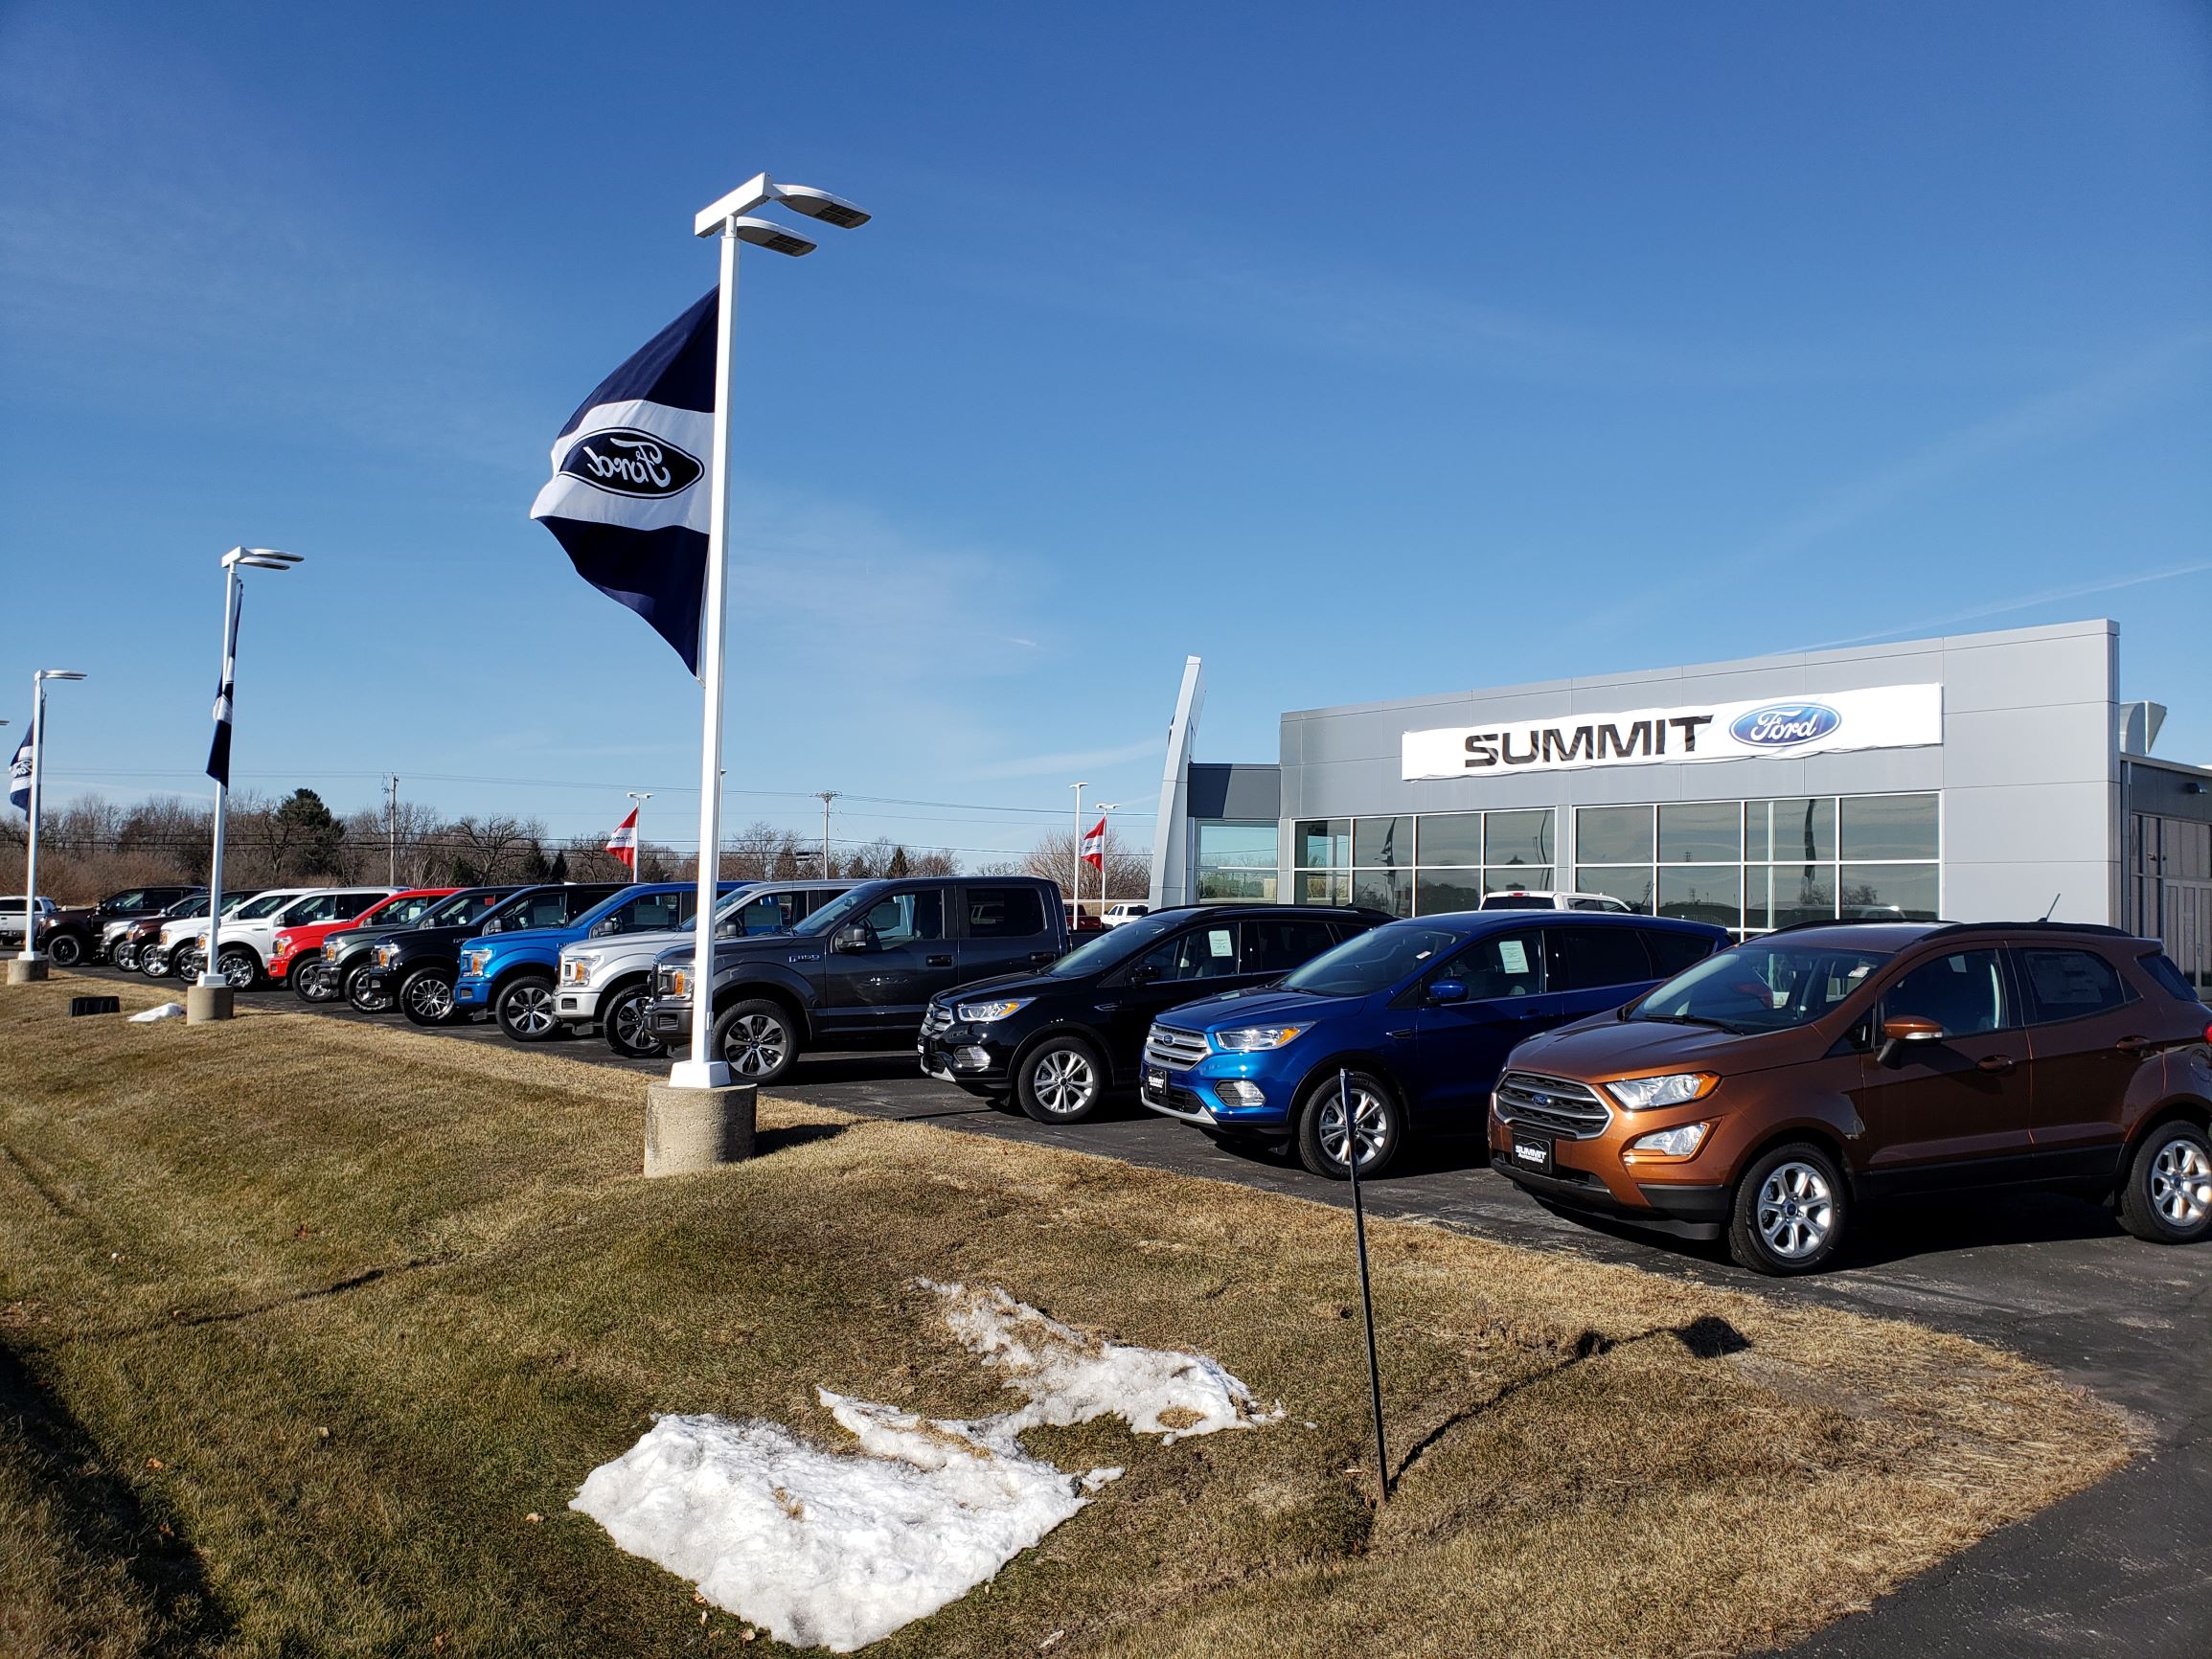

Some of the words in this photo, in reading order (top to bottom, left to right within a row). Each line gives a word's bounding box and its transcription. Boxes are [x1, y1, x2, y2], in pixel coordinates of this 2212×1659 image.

[1465, 715, 1714, 767] SUMMIT
[1750, 710, 1818, 740] Ford
[1515, 1145, 1547, 1159] SUMMIT
